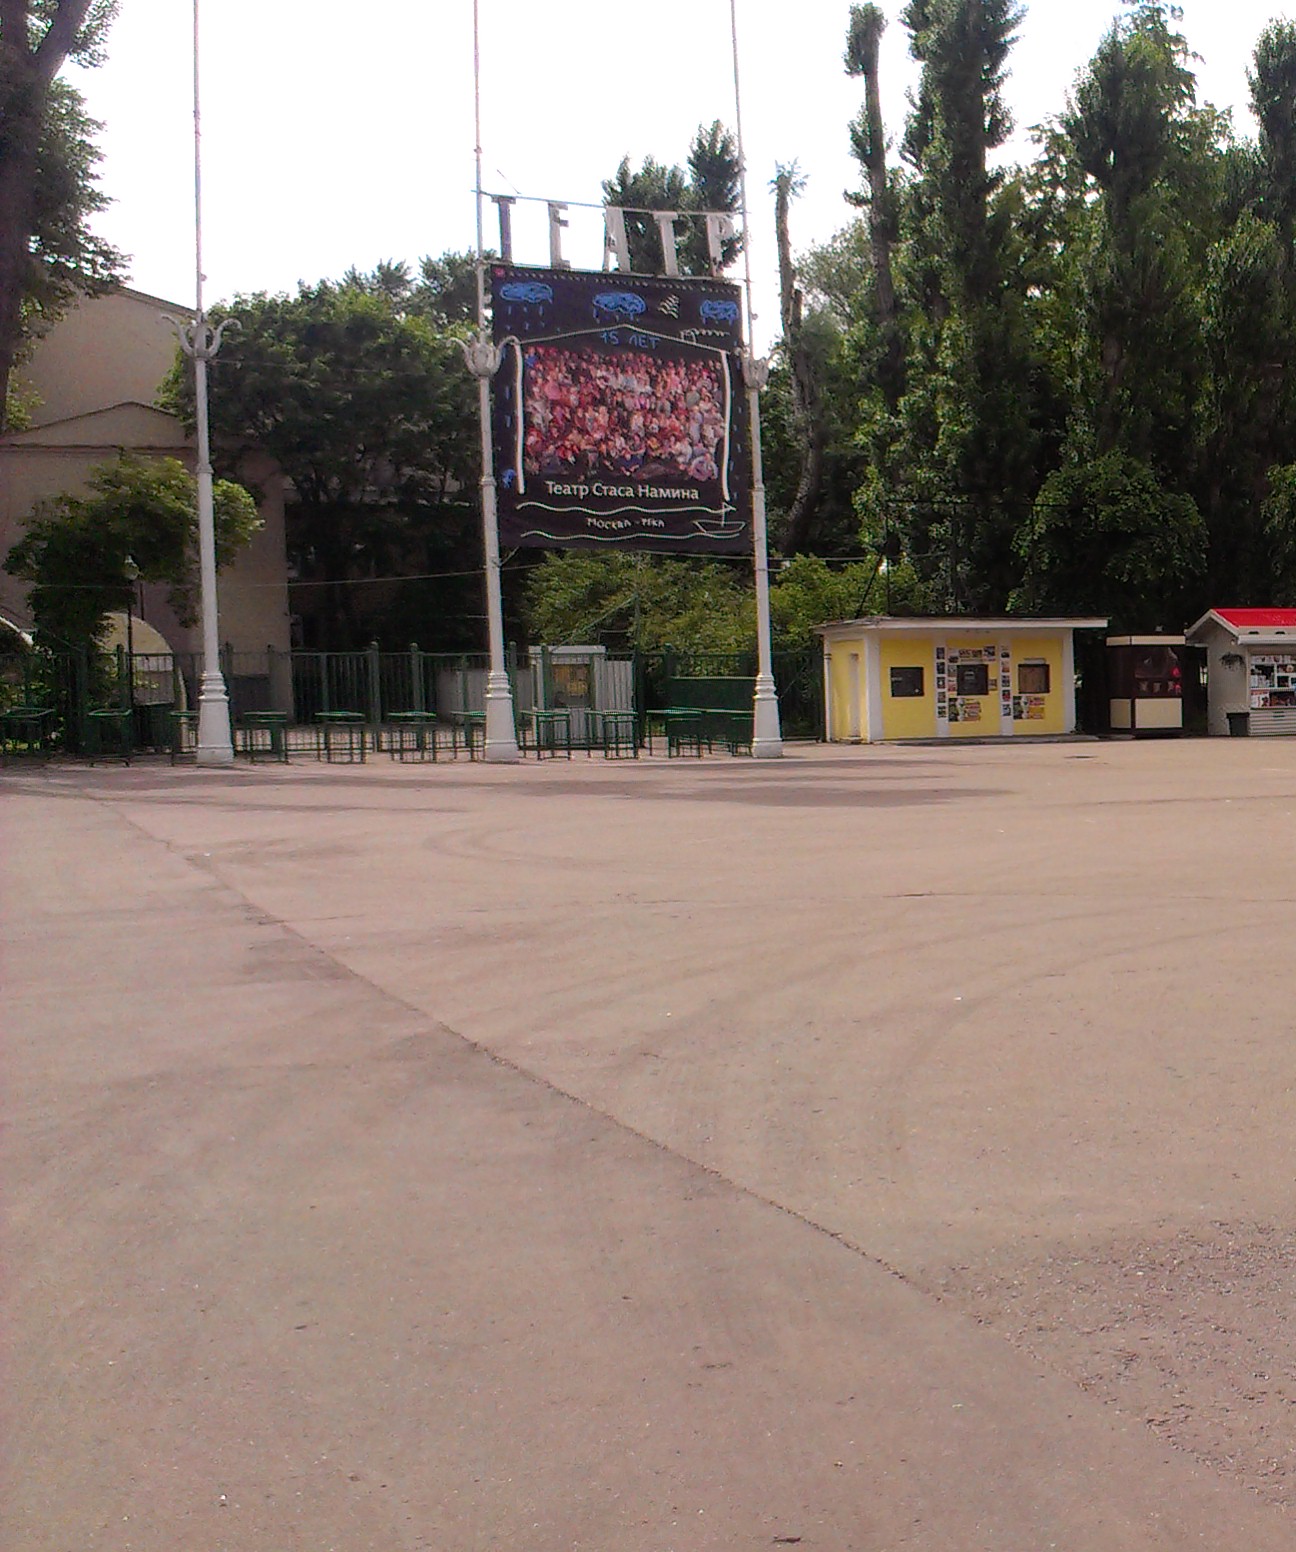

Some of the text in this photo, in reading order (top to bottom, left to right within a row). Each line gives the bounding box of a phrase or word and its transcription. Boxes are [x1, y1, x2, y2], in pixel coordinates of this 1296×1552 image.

[491, 195, 736, 277] ТЕАТР
[600, 330, 662, 349] 15 ЛЕТ
[544, 480, 700, 500] Театр Стаса Намина
